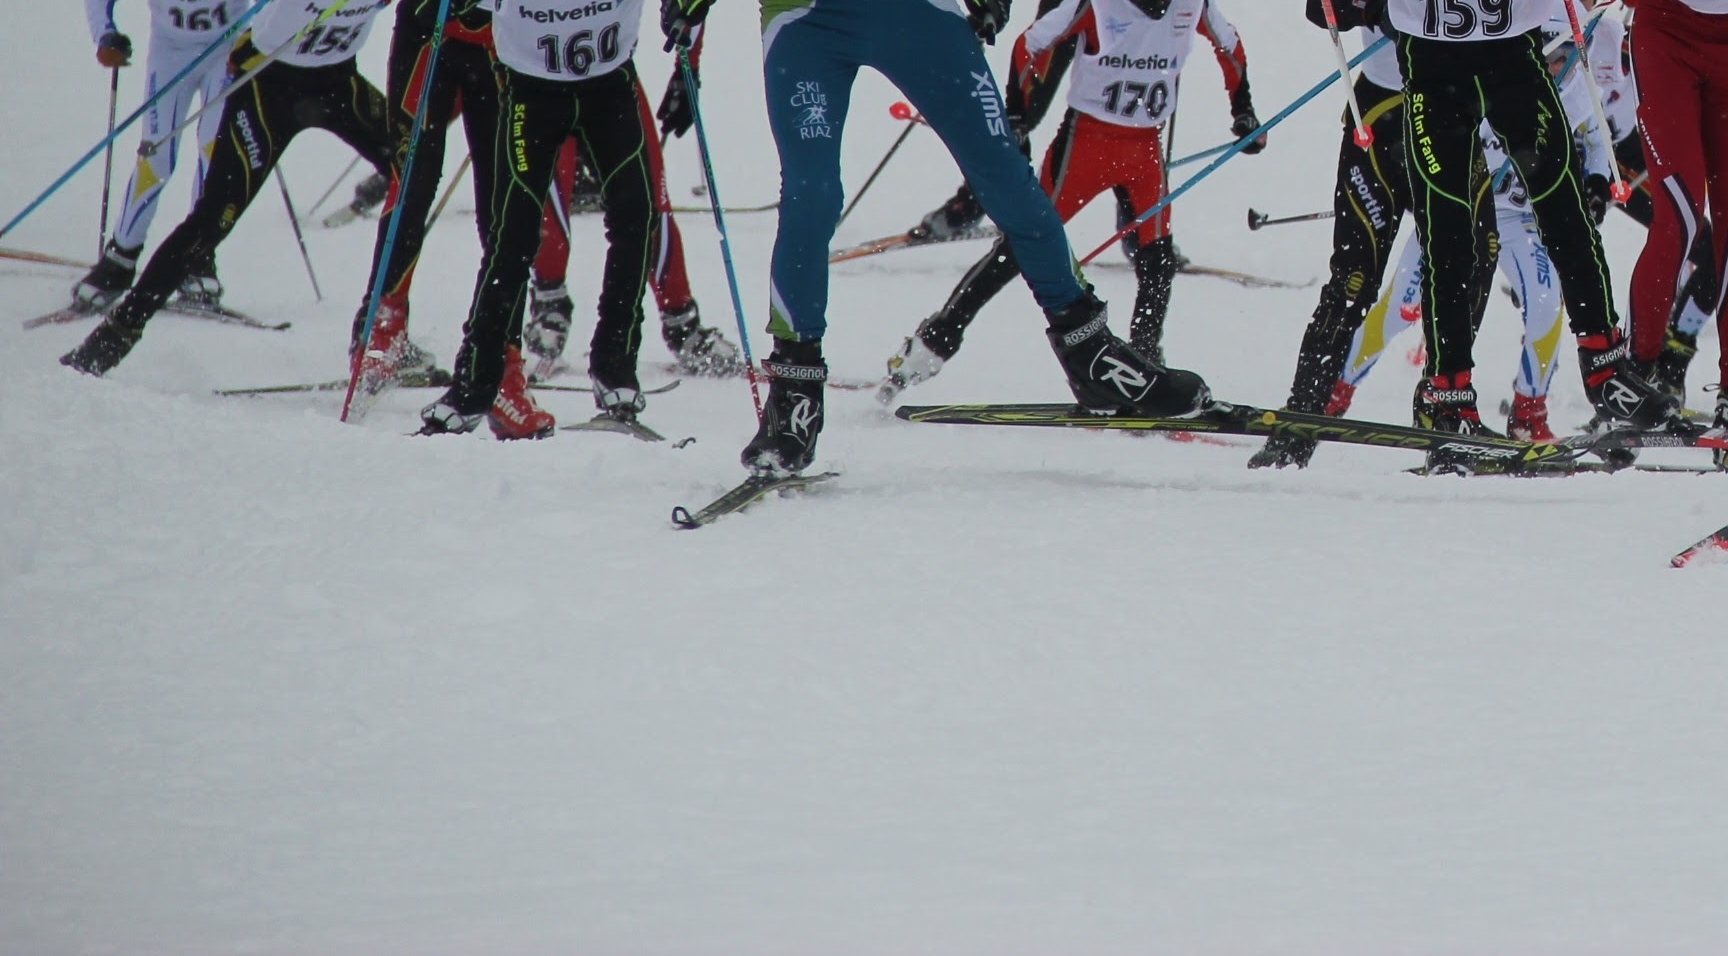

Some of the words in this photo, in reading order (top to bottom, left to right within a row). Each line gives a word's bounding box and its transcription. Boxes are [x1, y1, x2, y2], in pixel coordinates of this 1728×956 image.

[168, 3, 229, 31] 161
[518, 0, 613, 23] helvetia
[537, 21, 622, 76] 160
[796, 81, 820, 93] SKI
[1102, 79, 1168, 120] 170
[514, 103, 525, 120] SC
[236, 109, 263, 170] sportful
[800, 125, 832, 140] RIAZ
[1412, 93, 1424, 113] SC
[1419, 136, 1442, 175] Fang
[515, 139, 529, 172] Fang
[1350, 165, 1387, 230] sportful
[770, 364, 826, 380] ROSSIGNOL
[1438, 442, 1519, 459] FISCHER
